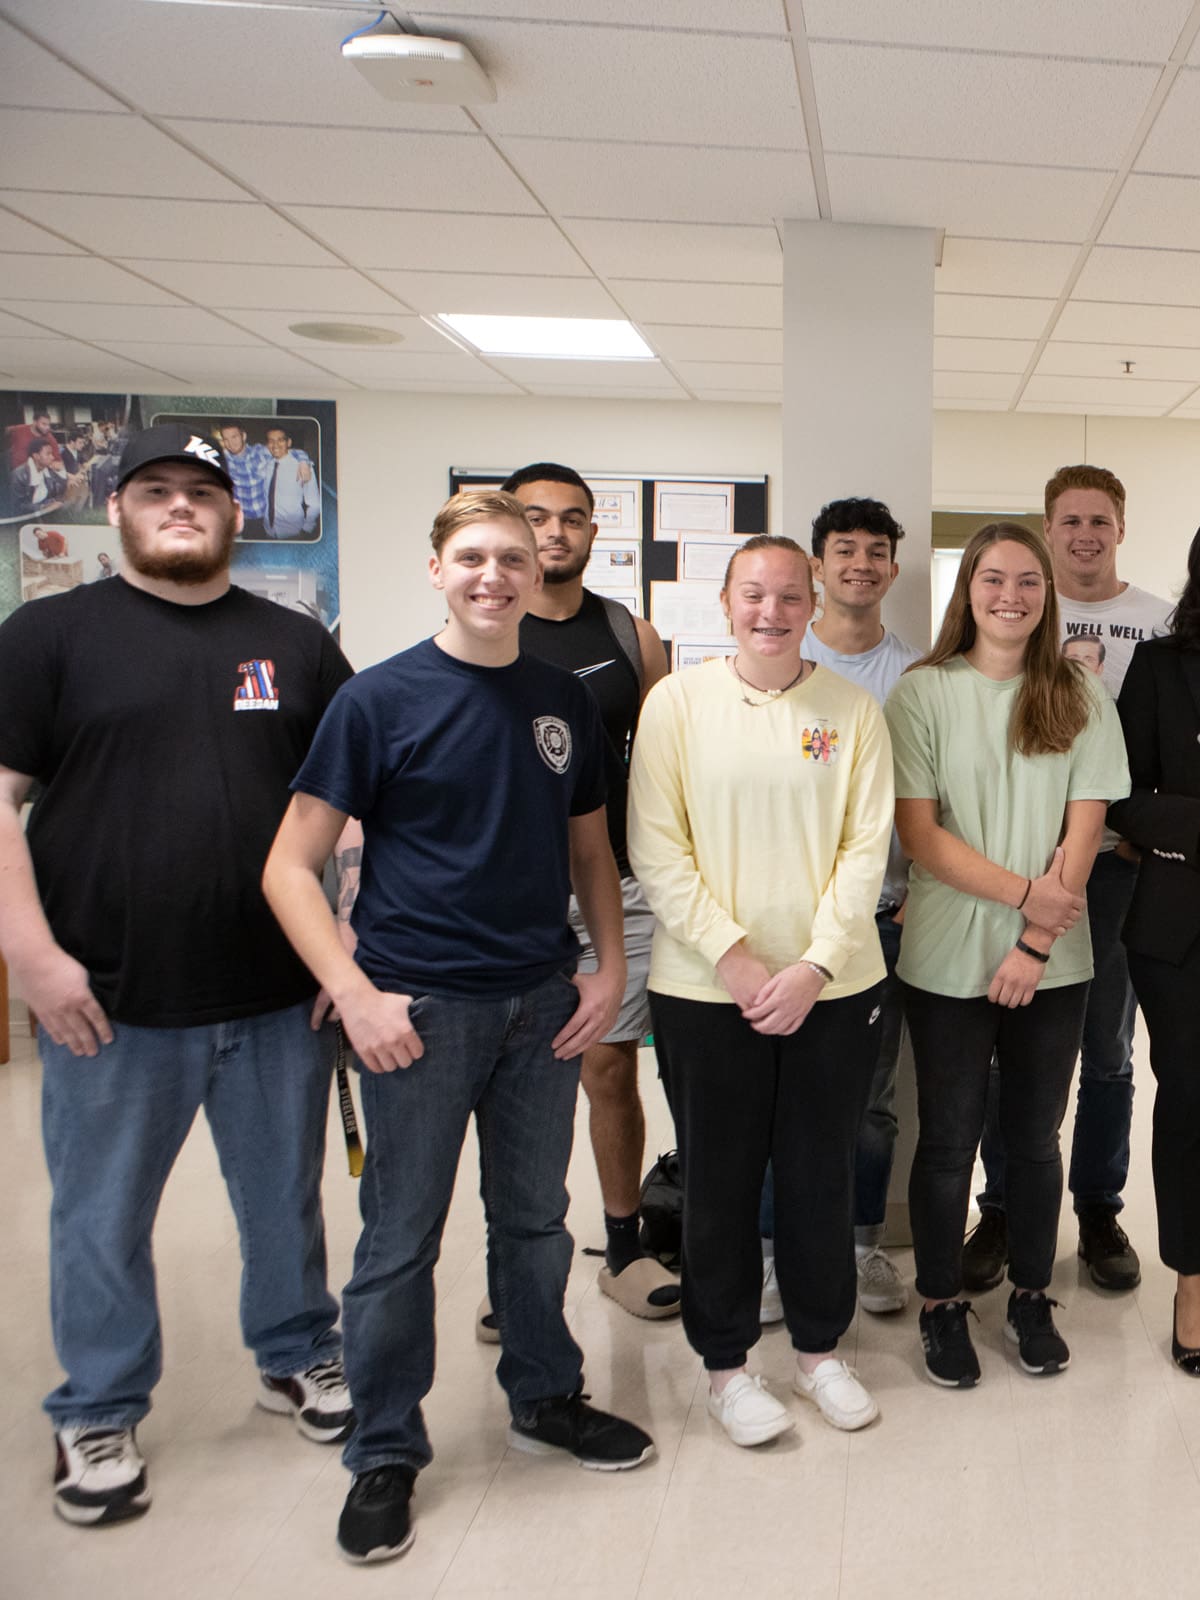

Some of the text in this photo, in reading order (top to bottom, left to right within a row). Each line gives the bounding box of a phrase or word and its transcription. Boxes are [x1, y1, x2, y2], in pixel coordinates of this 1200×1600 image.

[1066, 622, 1145, 641] WELL WELL
[340, 1087, 357, 1134] STEELERS
